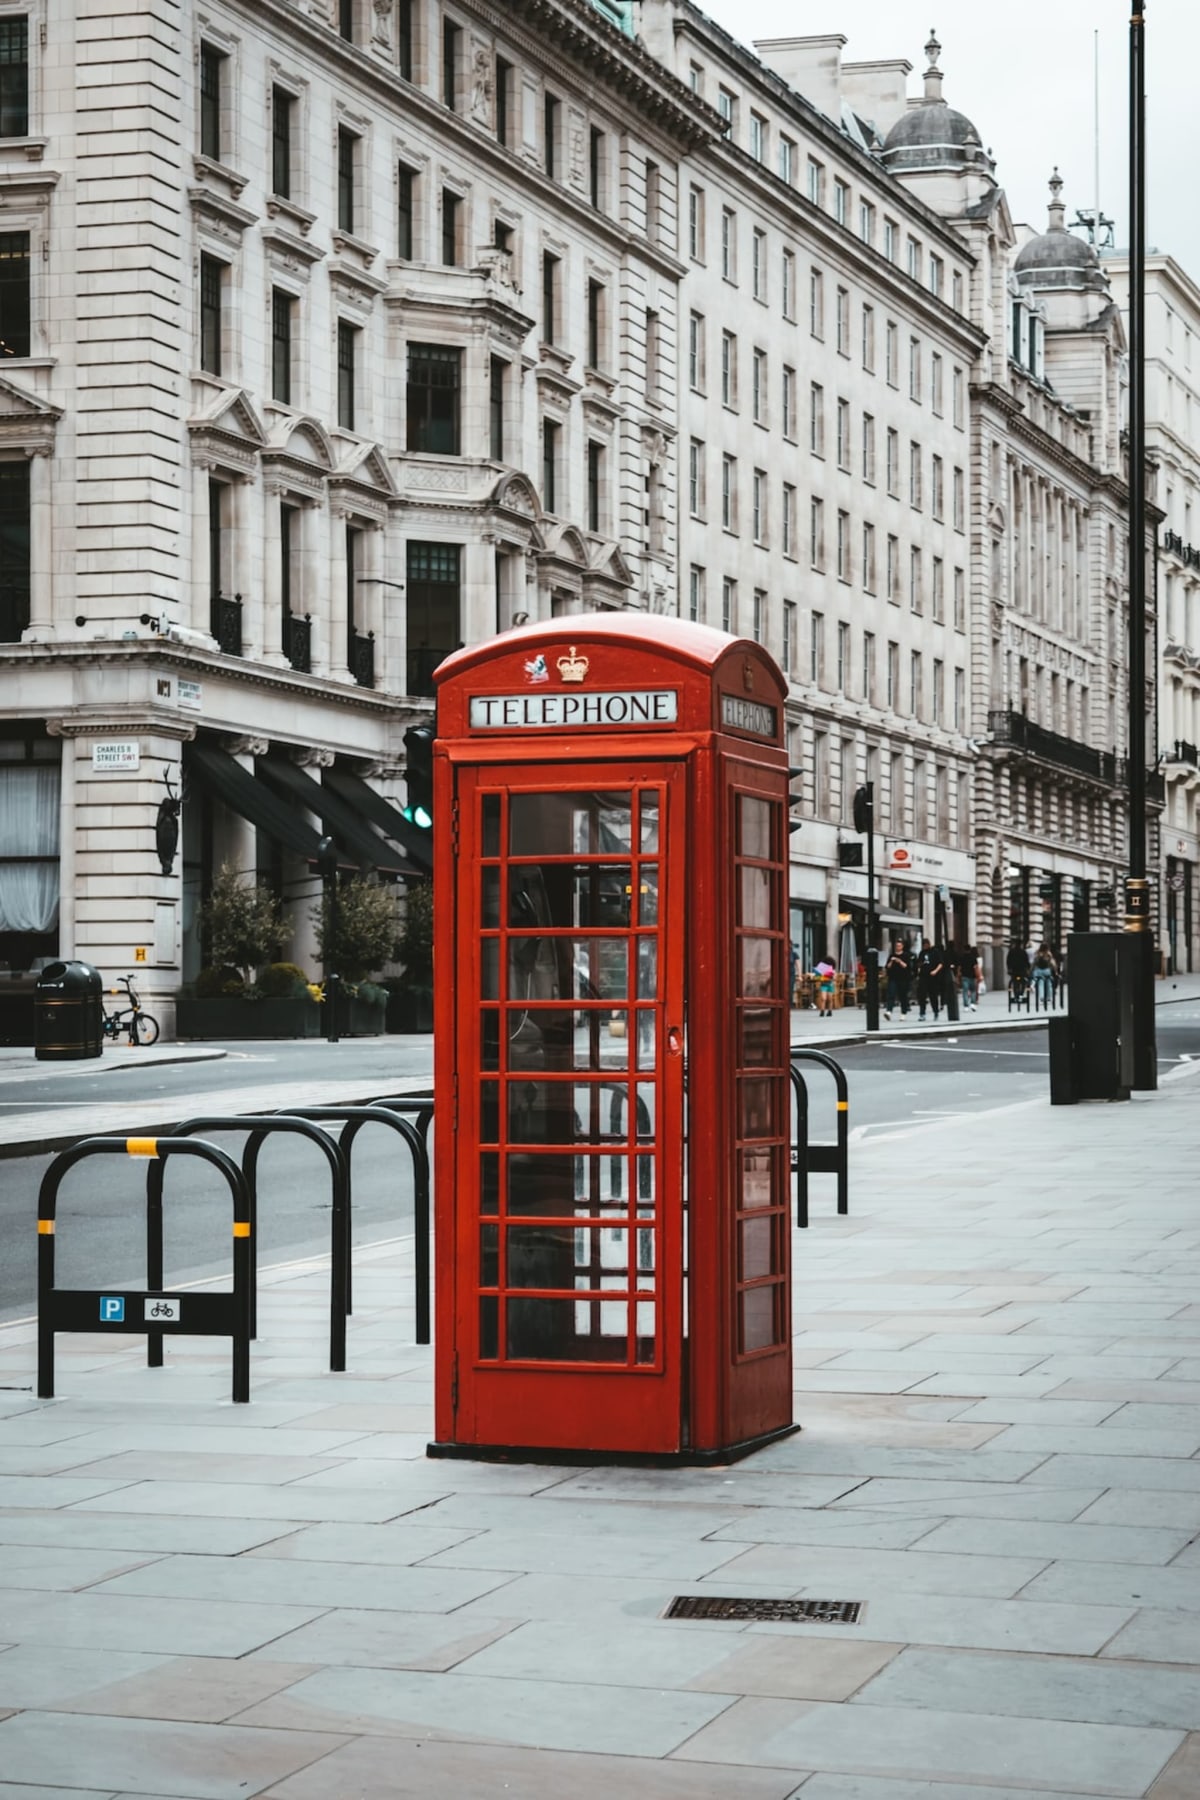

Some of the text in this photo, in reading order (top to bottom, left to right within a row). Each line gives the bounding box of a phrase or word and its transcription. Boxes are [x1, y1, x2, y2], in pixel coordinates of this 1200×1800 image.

[479, 695, 669, 726] TELEPHONE
[725, 698, 772, 736] ELEPHONE
[96, 745, 126, 754] CHARLES
[96, 754, 120, 762] STREET
[136, 948, 146, 961] H
[106, 1300, 120, 1319] P
